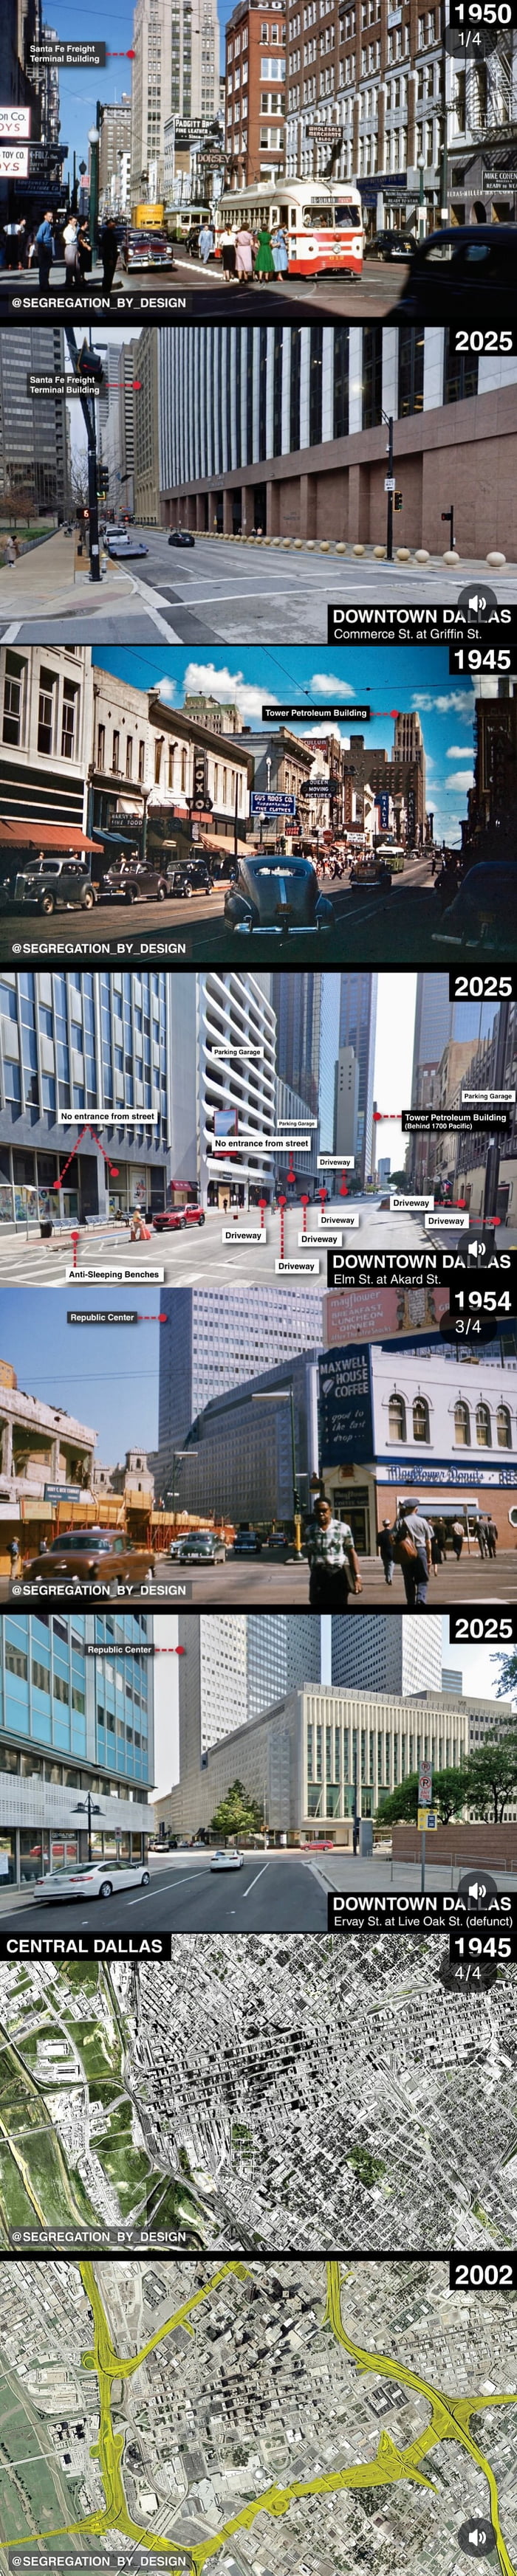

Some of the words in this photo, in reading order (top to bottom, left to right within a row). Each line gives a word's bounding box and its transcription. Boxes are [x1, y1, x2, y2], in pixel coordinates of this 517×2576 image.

[10, 111, 27, 121] Co.
[175, 120, 201, 128] PADGITT
[197, 154, 232, 163] DORSEY
[195, 757, 205, 793] FOX
[331, 1292, 381, 1308] mayflower
[332, 1304, 382, 1318] BREAKFAST
[332, 1311, 383, 1326] LUNCHEON
[340, 1321, 375, 1331] DINNER
[321, 1355, 367, 1374] MAXWELL
[336, 1368, 368, 1384] HOUSE
[335, 1382, 369, 1397] COFFEE
